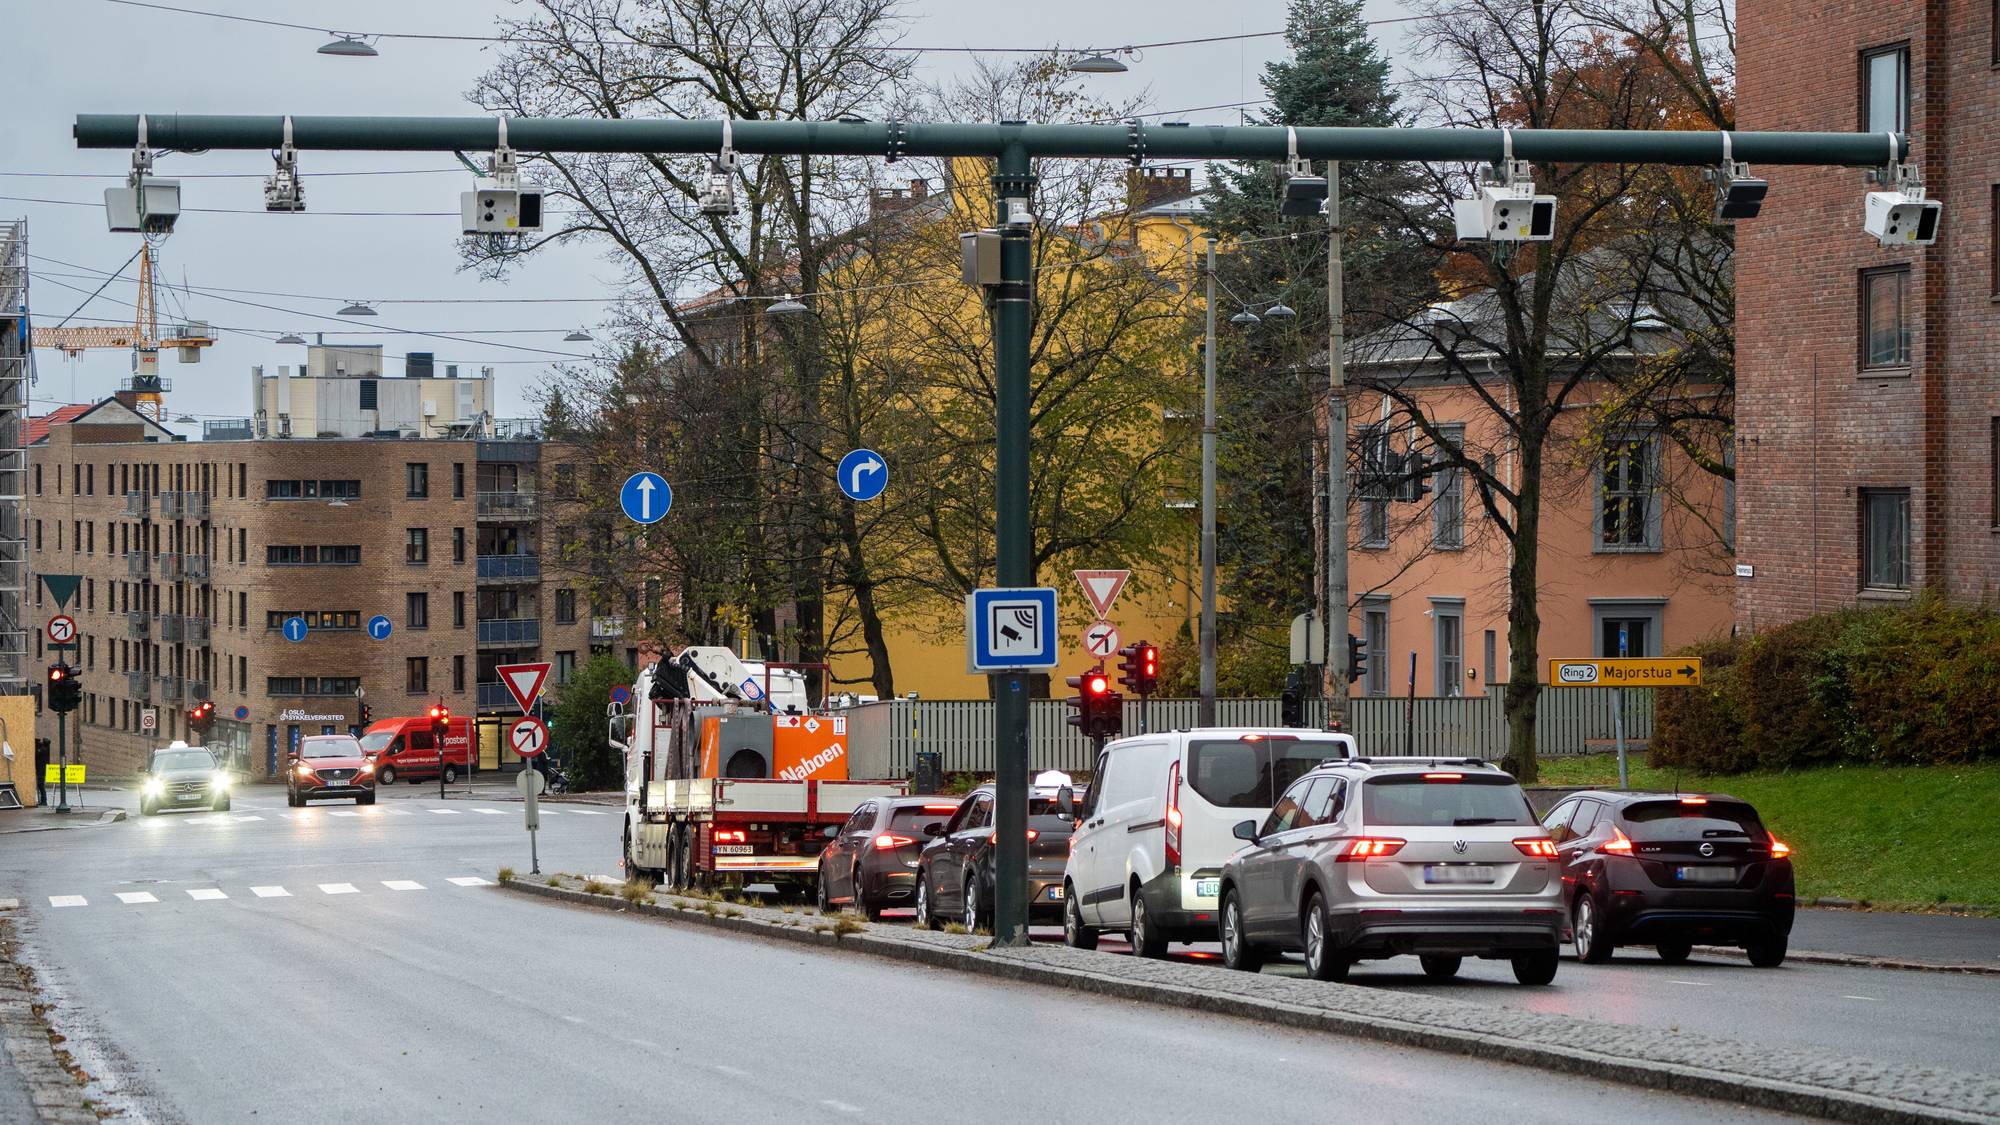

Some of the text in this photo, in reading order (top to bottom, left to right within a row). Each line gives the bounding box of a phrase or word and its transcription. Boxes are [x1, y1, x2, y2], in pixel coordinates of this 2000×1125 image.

[1564, 666, 1672, 681] Ring 2 Majorstua
[445, 735, 468, 746] posten
[779, 743, 844, 780] Naboen
